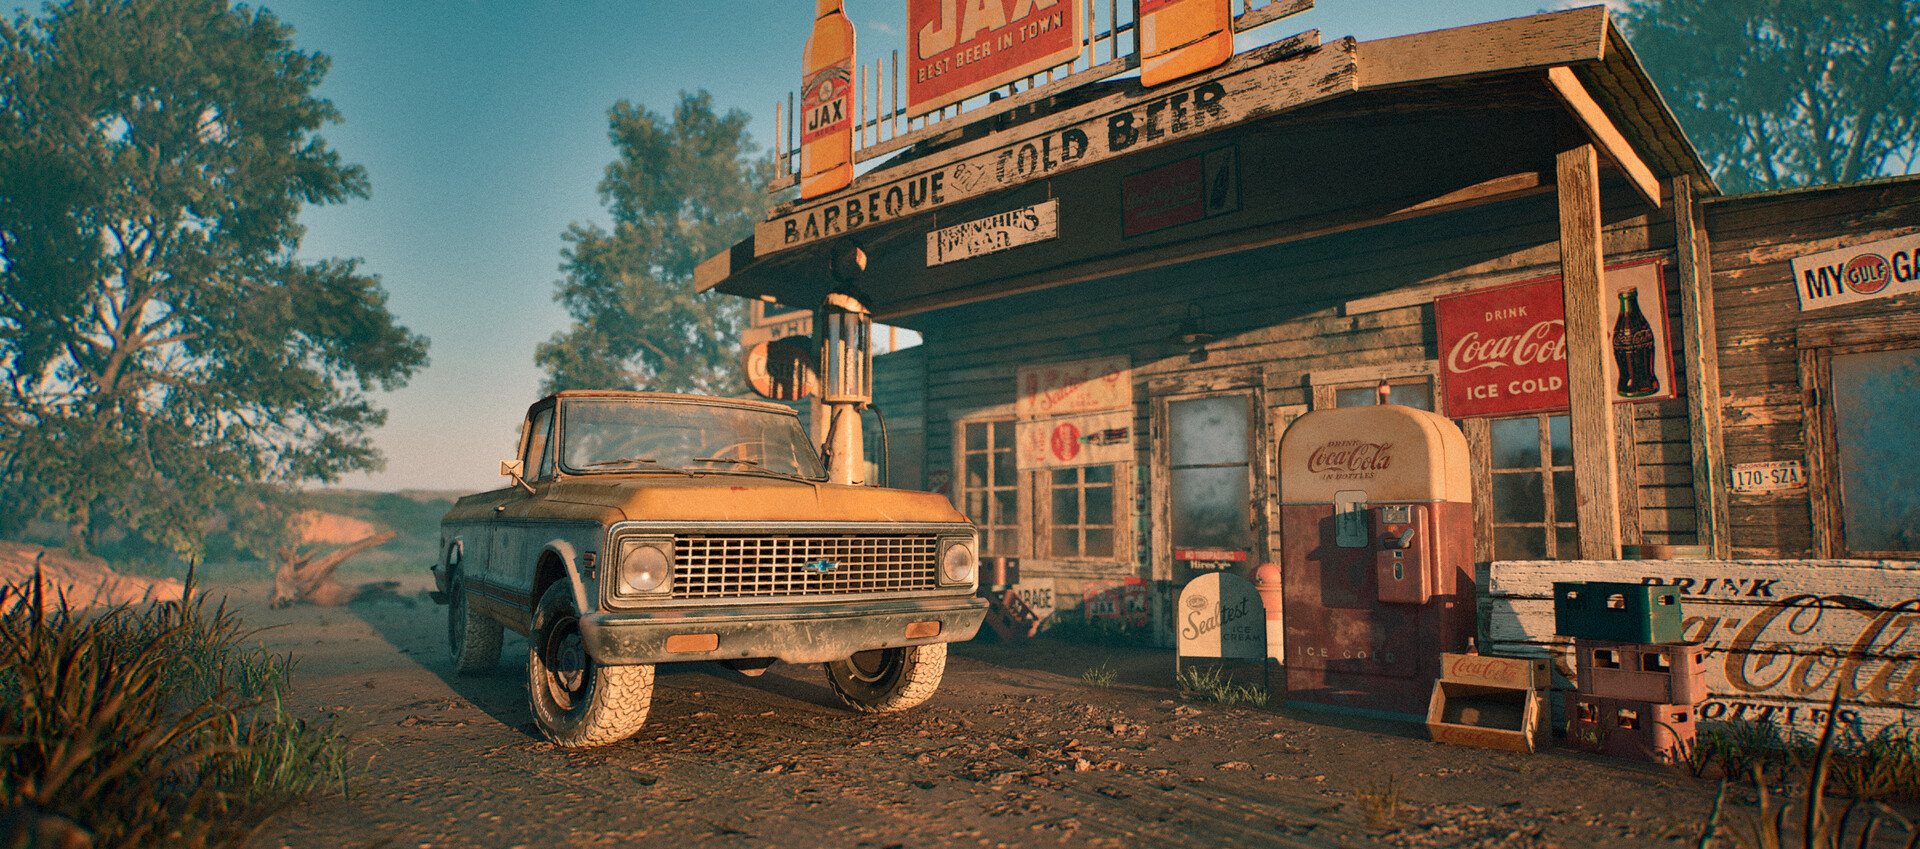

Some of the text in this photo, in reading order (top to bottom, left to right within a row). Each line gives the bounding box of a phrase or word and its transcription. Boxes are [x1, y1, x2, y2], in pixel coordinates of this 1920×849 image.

[918, 0, 1061, 59] JA
[917, 10, 1064, 84] BEST BEER IN TOWN
[809, 99, 842, 131] JAX
[785, 171, 945, 244] BARBEQUE
[995, 127, 1089, 184] COLD
[1108, 81, 1229, 152] BEER
[1802, 262, 1845, 299] MY
[1849, 262, 1886, 285] GULF
[1485, 306, 1527, 322] DRINK
[1448, 320, 1567, 373] Coca-Col
[1467, 376, 1562, 400] ICE COLD
[1328, 440, 1360, 448] DRINK
[1308, 442, 1394, 473] Coca-Cola
[1336, 472, 1375, 480] BOTTLES
[1737, 468, 1798, 485] 170-SZA
[1182, 596, 1249, 640] Sealtest
[1223, 633, 1261, 641] CREAM
[1297, 646, 1394, 663] ICE COLD
[1452, 657, 1516, 681] Coca-Cola
[1694, 701, 1859, 726] OTTLES
